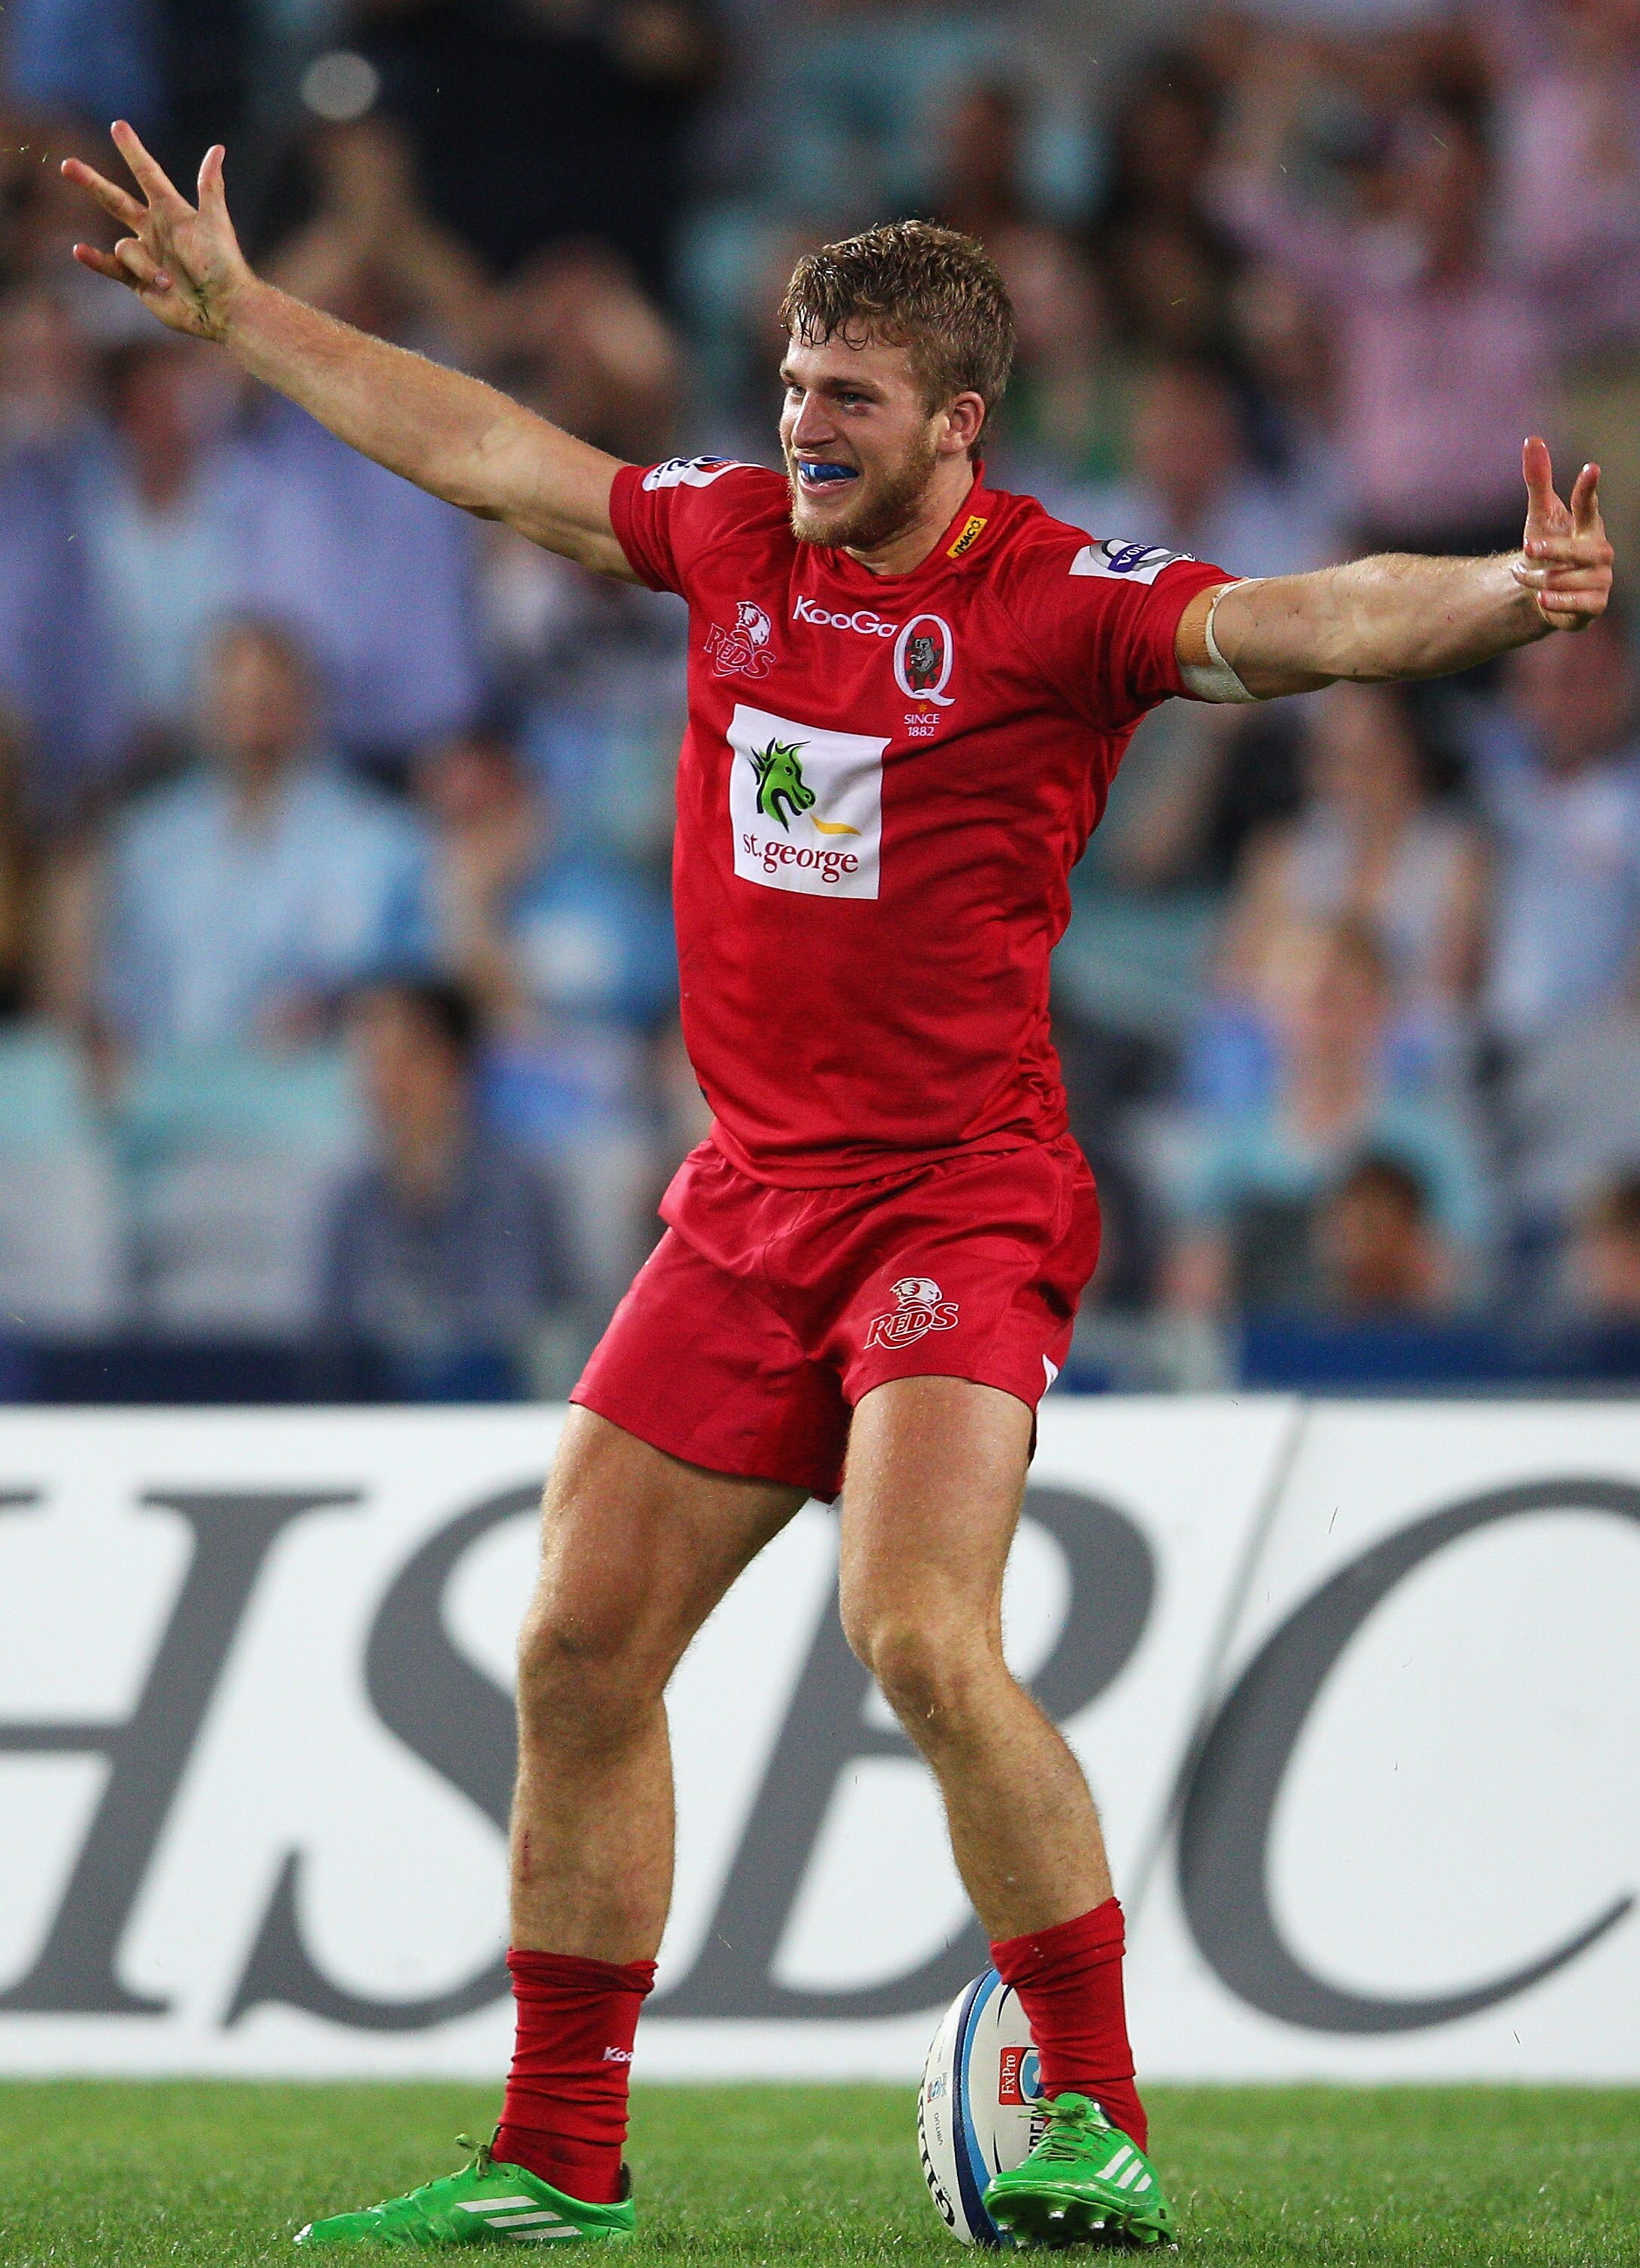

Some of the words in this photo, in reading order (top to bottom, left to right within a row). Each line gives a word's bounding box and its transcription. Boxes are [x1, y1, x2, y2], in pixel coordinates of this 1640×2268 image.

[1116, 544, 1154, 566] VOL
[793, 595, 898, 637] KooGa
[703, 622, 777, 679] REDS
[893, 614, 956, 707] Q
[904, 714, 941, 725] SINCE
[907, 727, 935, 737] 1882
[863, 1302, 960, 1349] REDS
[0, 1474, 1640, 2036] HSBC
[1001, 2054, 1016, 2095] FxPro
